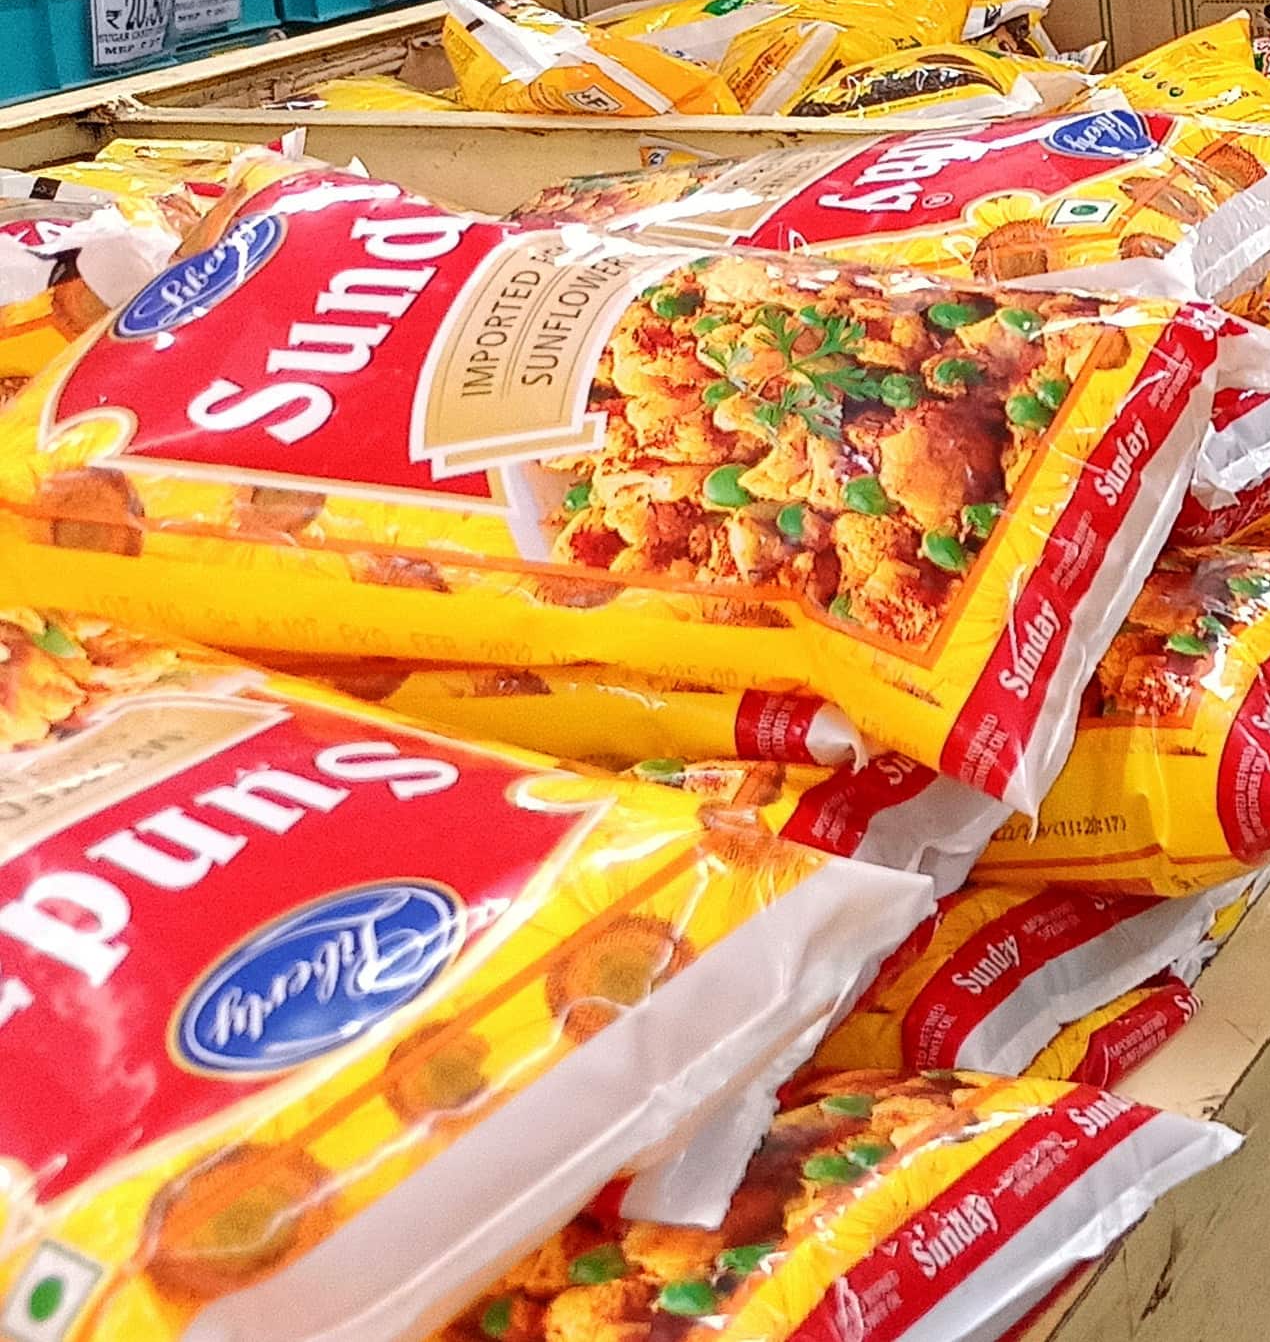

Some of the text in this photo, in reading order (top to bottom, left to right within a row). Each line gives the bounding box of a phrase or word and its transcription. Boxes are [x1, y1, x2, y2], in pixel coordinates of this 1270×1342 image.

[461, 267, 543, 399] IMPORTED
[520, 253, 631, 389] SUNFLOWER
[1093, 413, 1152, 508] Sunday
[998, 596, 1063, 700] Sunday
[951, 933, 1021, 996] Sunday
[910, 1191, 1000, 1282] Sunday
